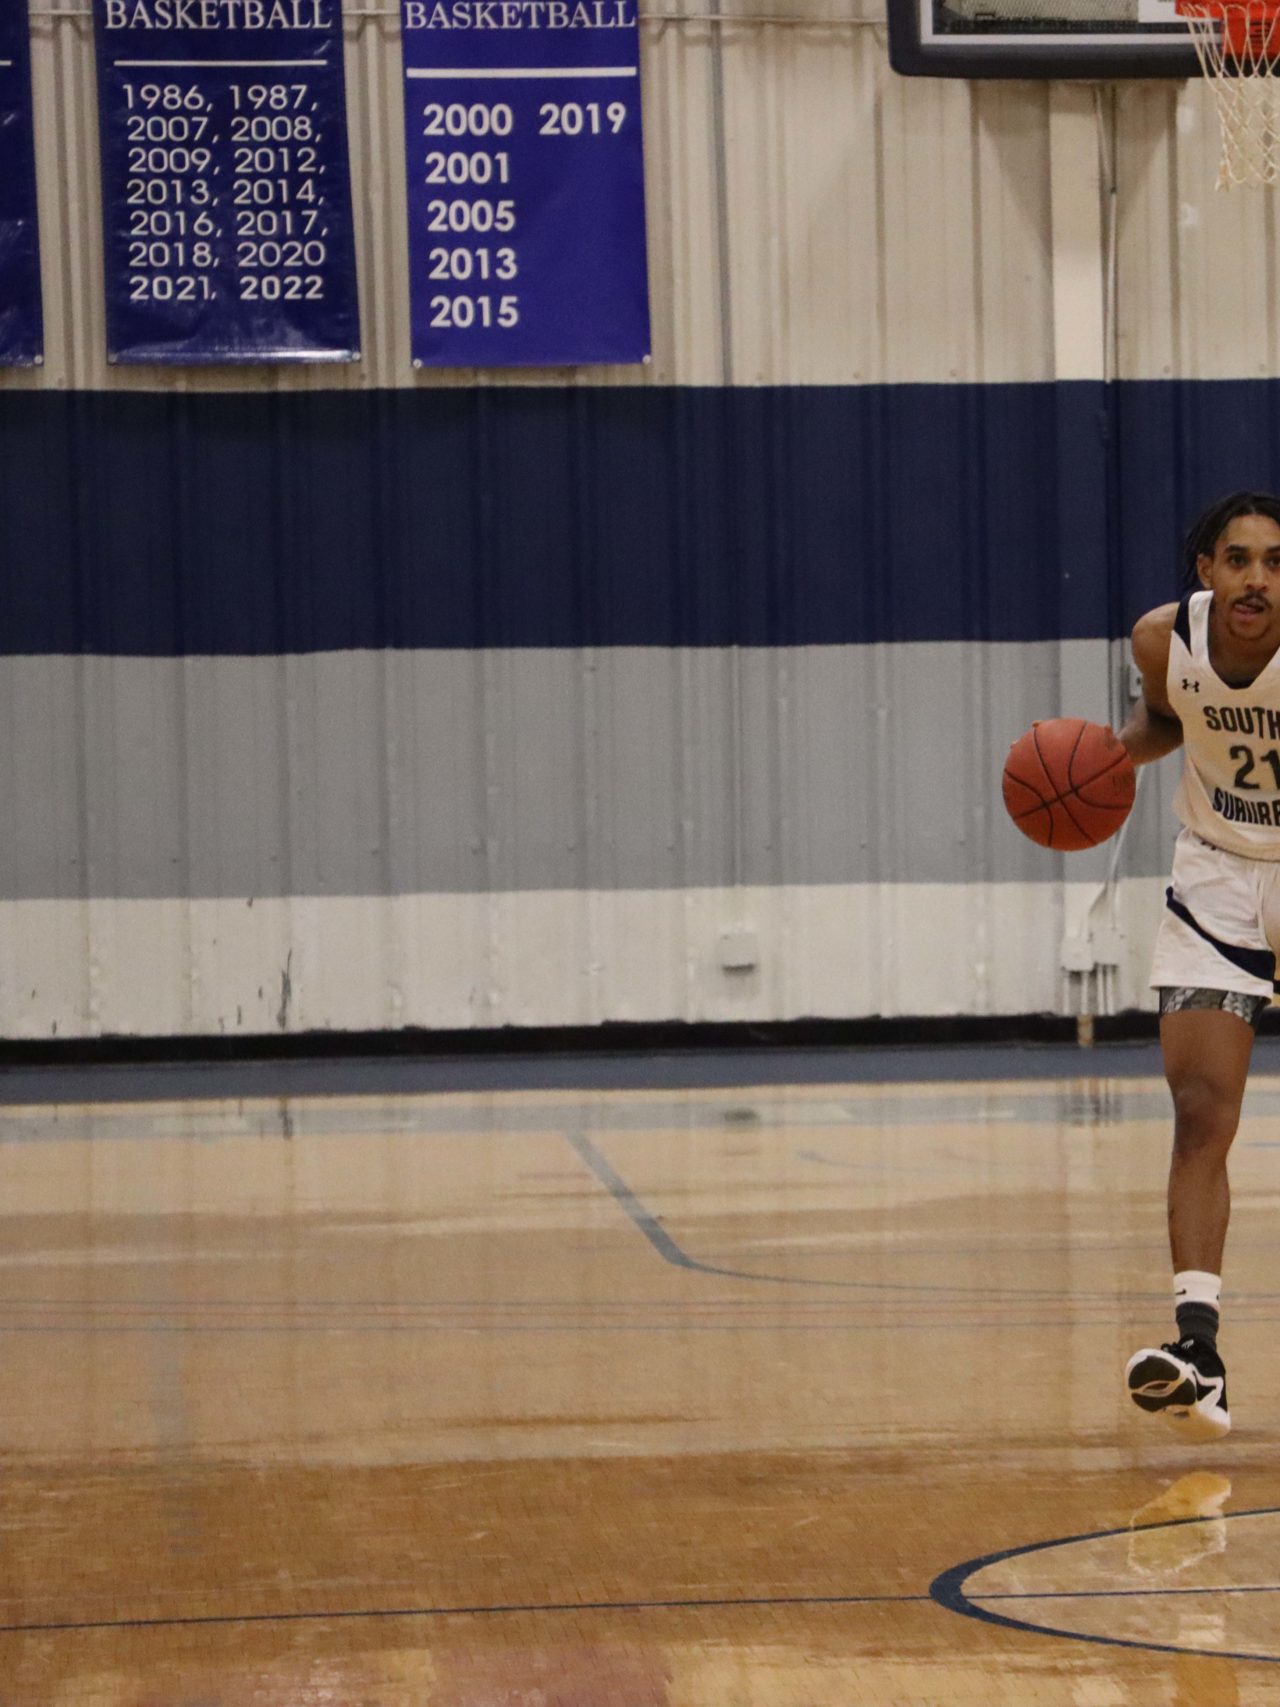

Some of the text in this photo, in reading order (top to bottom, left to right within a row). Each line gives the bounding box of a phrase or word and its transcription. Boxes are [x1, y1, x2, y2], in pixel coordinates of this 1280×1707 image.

[105, 0, 332, 29] BASKETBALL
[405, 1, 636, 29] BASKETBALL
[122, 84, 318, 112] 1986, 1987,
[127, 116, 321, 144] 2007, 2008,
[423, 102, 626, 136] 2000 2019
[128, 147, 326, 175] 2009, 2012,
[425, 152, 509, 184] 2001
[127, 179, 324, 207] 2013, 2014,
[130, 210, 328, 237] 2016, 2017,
[427, 200, 516, 232] 2005
[129, 241, 326, 268] 2018, 2020
[428, 248, 518, 280] 2013
[129, 275, 324, 300] 2021, 2022
[430, 296, 519, 328] 2015
